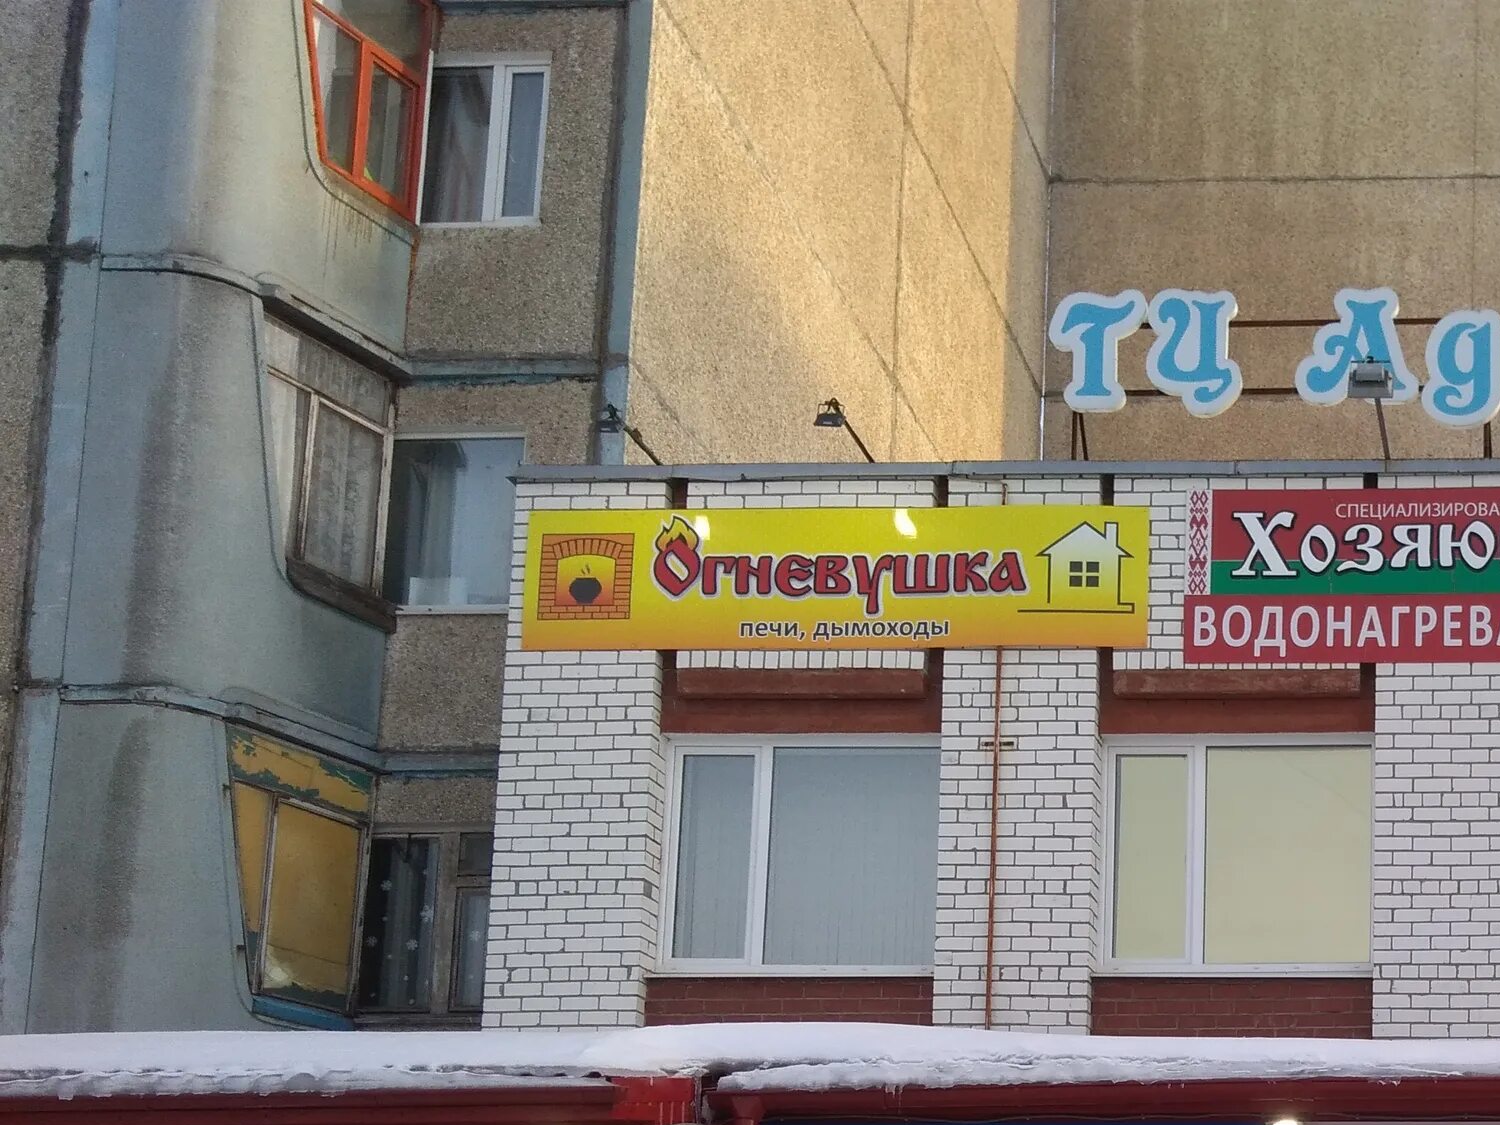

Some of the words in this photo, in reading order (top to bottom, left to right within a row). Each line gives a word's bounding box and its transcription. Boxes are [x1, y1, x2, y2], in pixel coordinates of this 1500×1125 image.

[1049, 288, 1240, 417] ТЦ
[652, 535, 1030, 616] Огневушка
[739, 621, 806, 640] печи,
[813, 619, 950, 640] дымоходы
